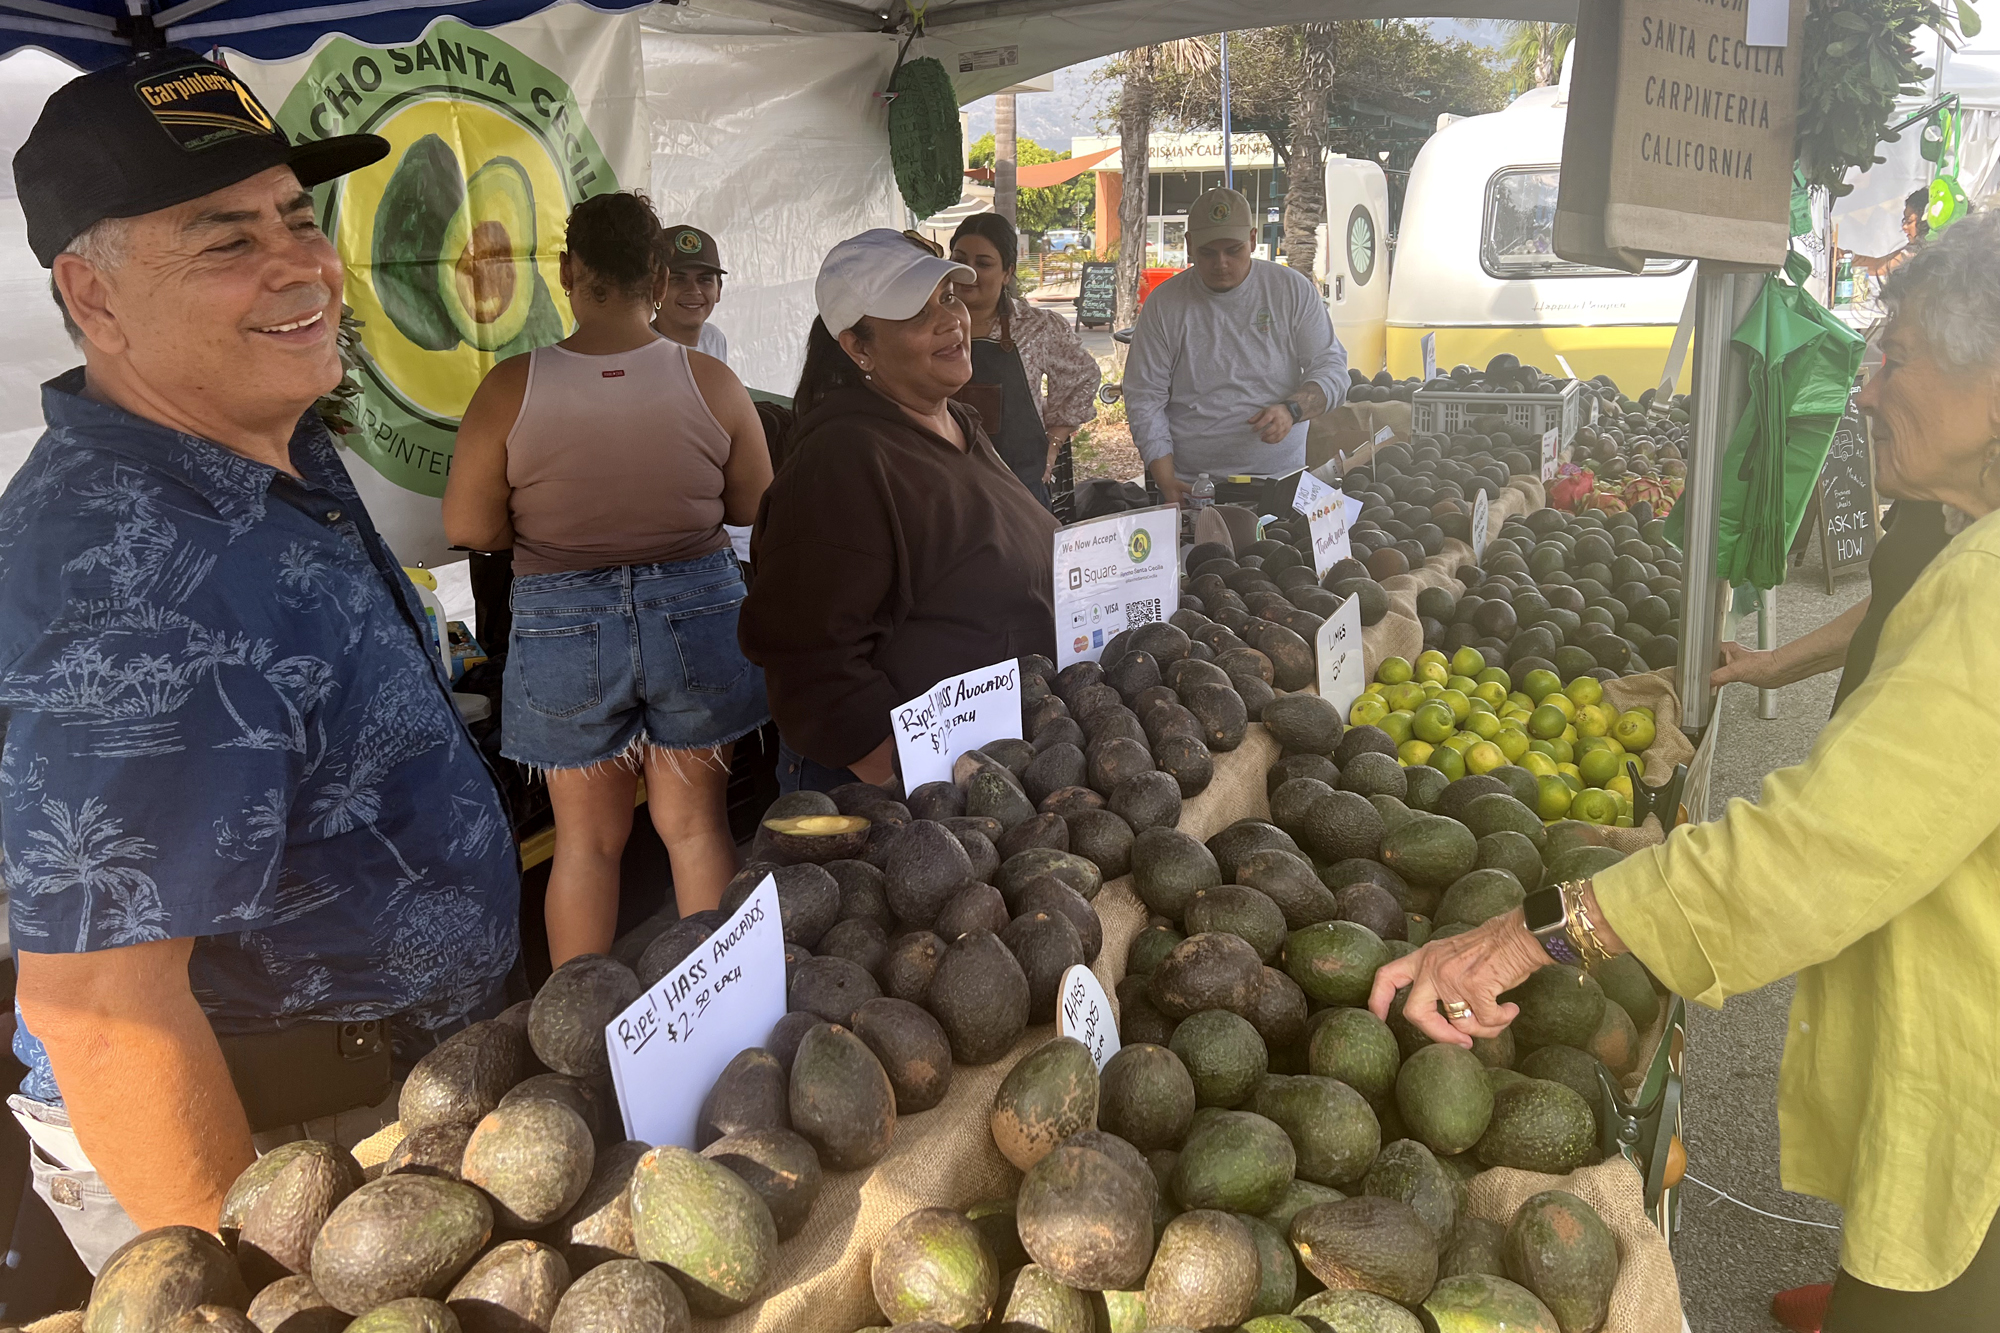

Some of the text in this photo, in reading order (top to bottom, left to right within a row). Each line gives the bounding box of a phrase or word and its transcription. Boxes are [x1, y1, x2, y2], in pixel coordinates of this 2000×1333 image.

[1641, 16, 1784, 77] SANTA CECILIA
[141, 71, 235, 106] Carpinteria
[1645, 75, 1769, 129] CARPINTERIA
[387, 38, 517, 97] SANTA
[530, 87, 597, 201] CECIL
[1149, 142, 1270, 158] RISMAN CALIORNIA
[1641, 131, 1753, 181] CALIFORNIA
[348, 395, 453, 477] ARPINTE
[1827, 510, 1869, 536] ASK ME
[1062, 532, 1117, 554] We Now Accept
[1837, 537, 1863, 561] HOW
[1084, 564, 1117, 584] Square
[1104, 602, 1119, 615] VISA
[1154, 598, 1162, 621] nmo
[1329, 623, 1346, 651] LIMES
[935, 685, 951, 716] HASS
[664, 959, 708, 1012] HASS
[714, 966, 742, 993] EACH
[1064, 976, 1086, 1031] HASS
[1083, 1000, 1100, 1050] CADOS
